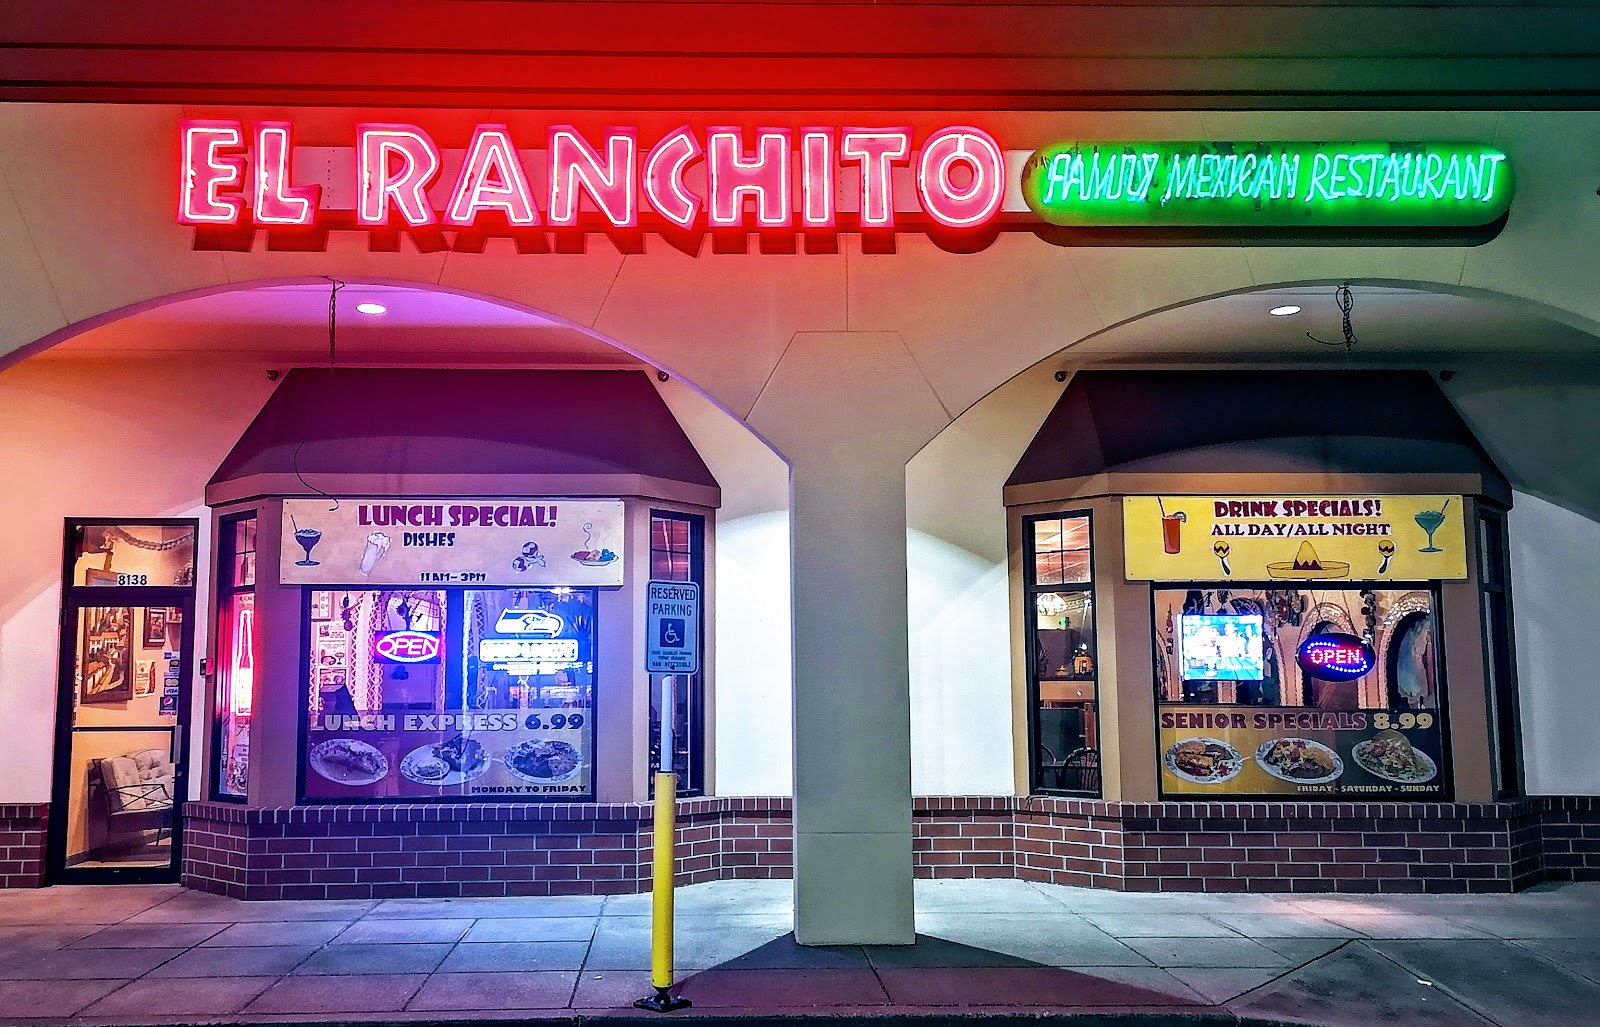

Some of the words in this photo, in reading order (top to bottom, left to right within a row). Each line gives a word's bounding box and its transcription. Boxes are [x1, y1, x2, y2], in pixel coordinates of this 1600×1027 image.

[179, 120, 322, 226] EL
[355, 123, 1008, 229] RANCHITO
[1305, 152, 1505, 202] RESTAURANT
[358, 505, 445, 527] LUNCH
[449, 505, 558, 527] SPECIAL!
[1214, 500, 1279, 518] DRINK
[1282, 499, 1382, 517] SPECIALS!
[1211, 524, 1245, 536] ALL
[1249, 523, 1330, 538] DAY/ALL
[1333, 523, 1391, 536] NIGHT
[403, 532, 456, 547] DISHES
[117, 574, 148, 586] 8138
[651, 587, 696, 600] RESERVED
[652, 603, 692, 616] PARKING
[376, 636, 440, 656] OPEN
[1310, 648, 1361, 665] OPEN
[309, 714, 396, 731] LUNCH
[403, 714, 518, 731] EXPRESS
[524, 713, 585, 730] 6.99
[1161, 713, 1248, 730] SENIOR
[1253, 713, 1368, 730] SPECIALS
[1373, 712, 1434, 730] 8.99
[525, 785, 540, 793] TO
[542, 785, 586, 793] FRIDAY
